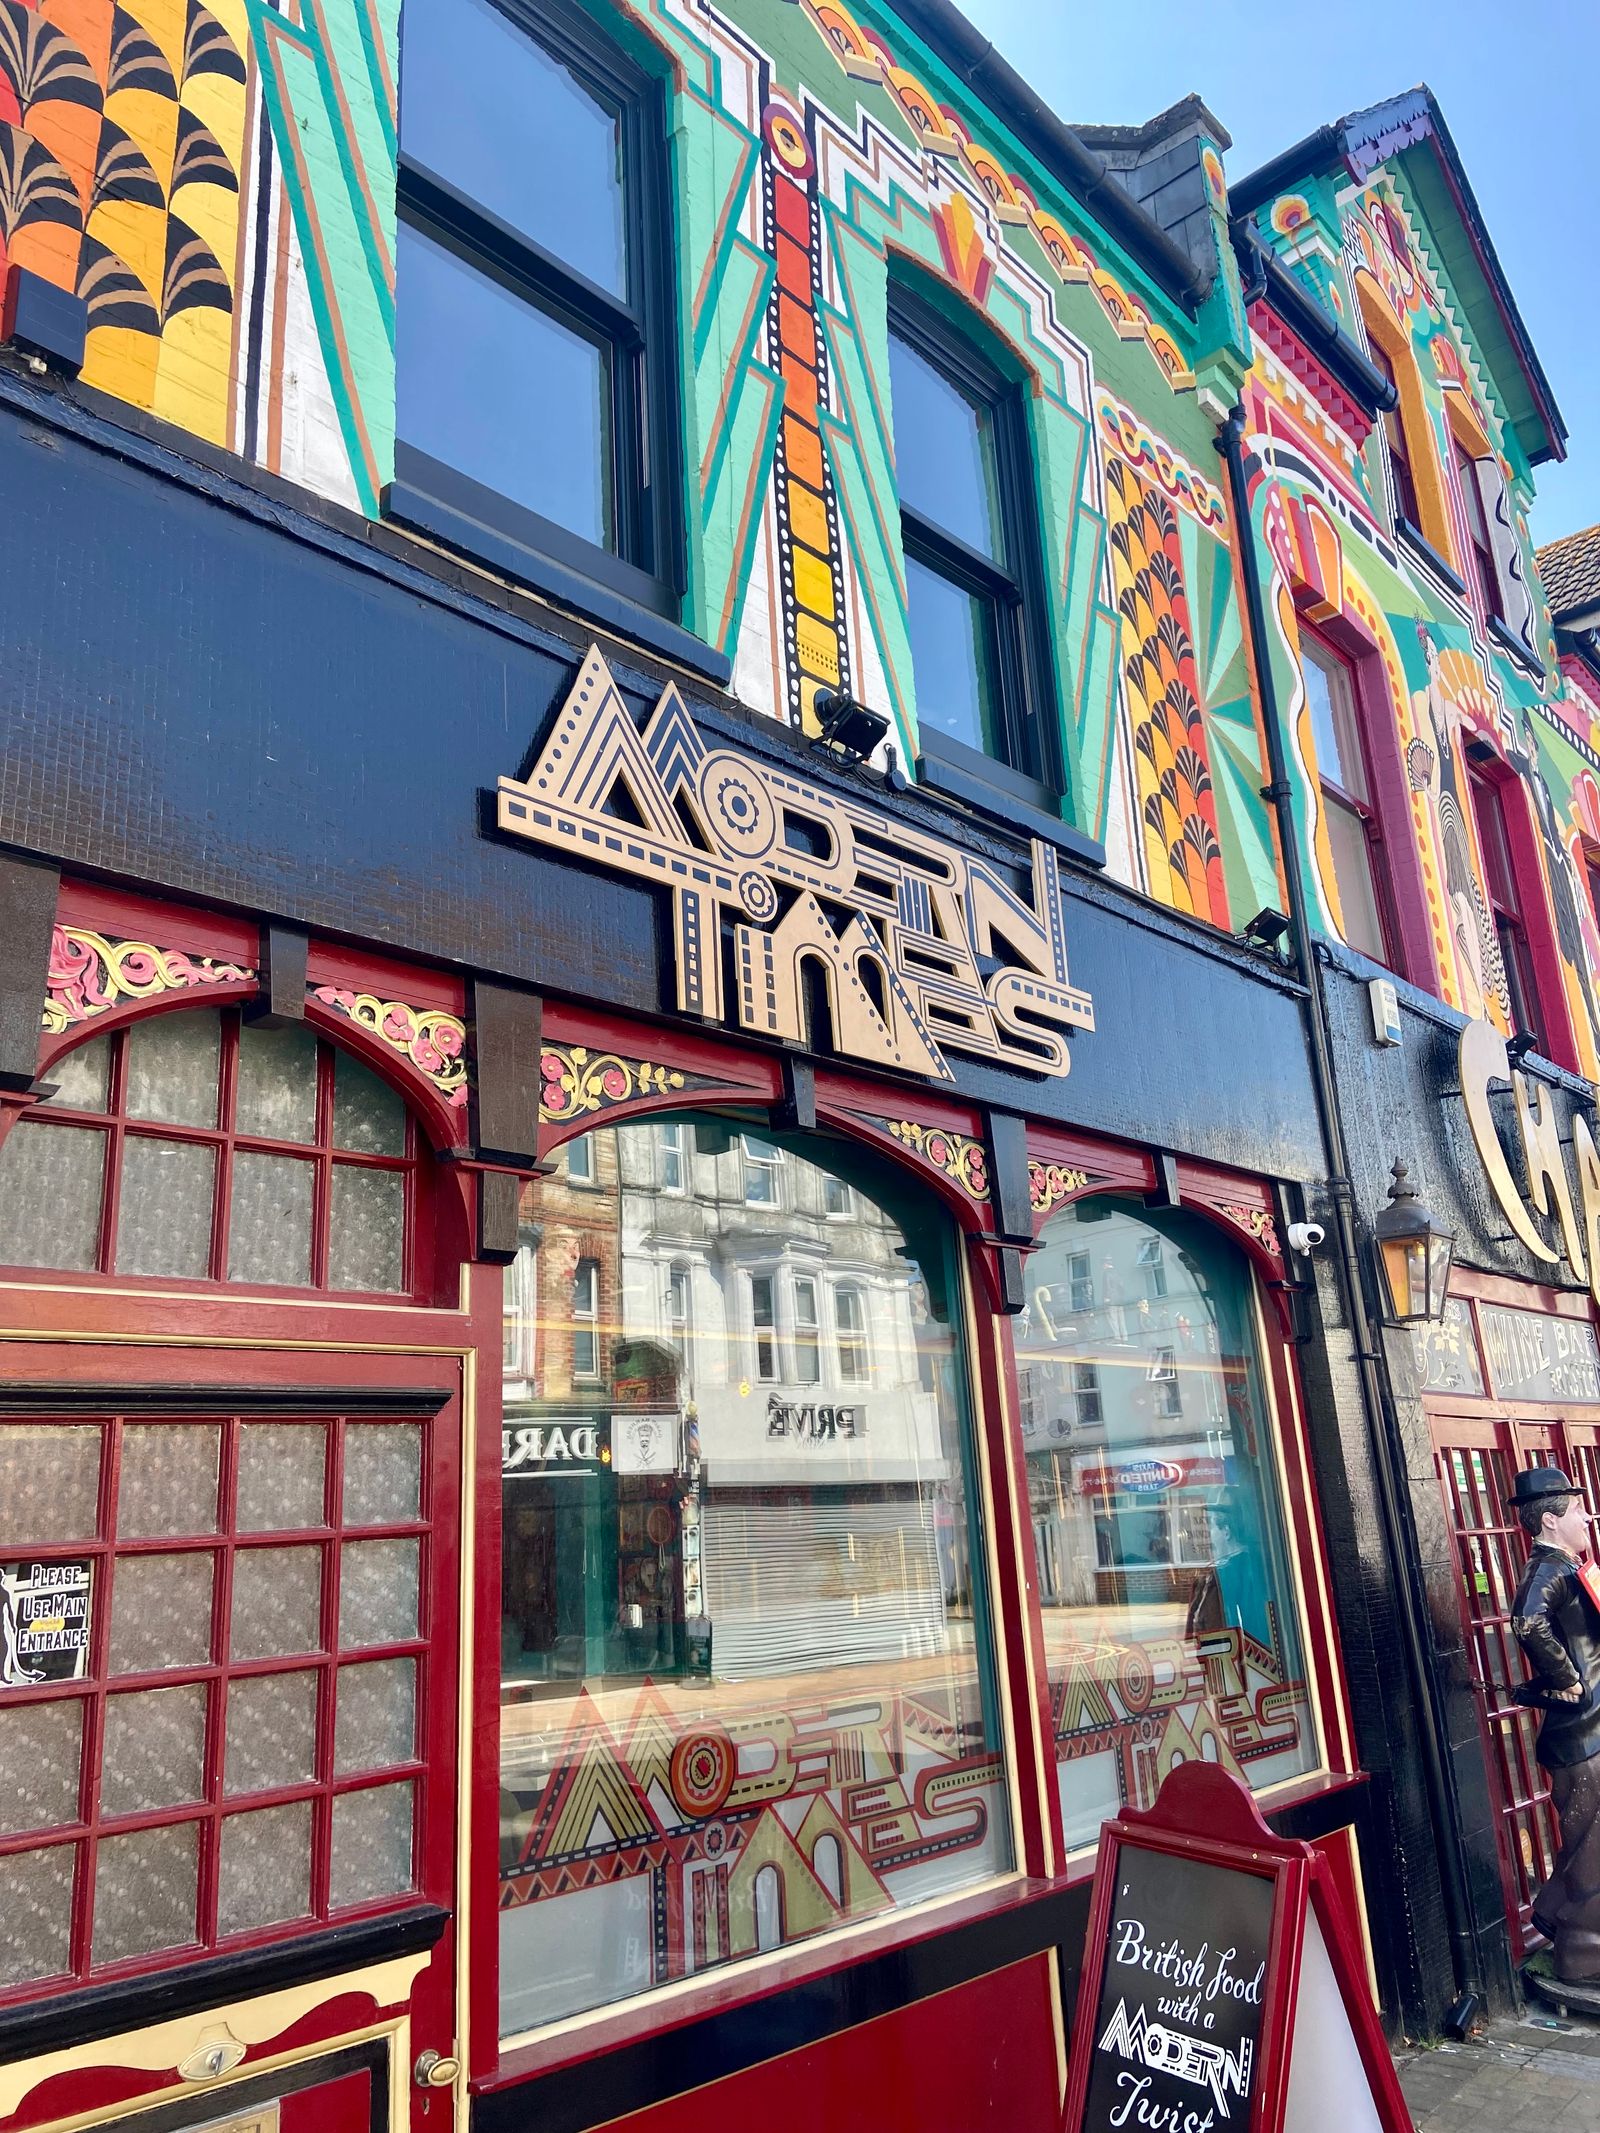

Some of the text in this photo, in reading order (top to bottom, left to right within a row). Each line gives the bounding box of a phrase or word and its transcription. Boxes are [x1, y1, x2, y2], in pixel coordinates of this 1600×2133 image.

[524, 643, 1069, 985] MODERN
[498, 776, 1095, 1082] TIMES
[1480, 1310, 1550, 1388] WINE
[24, 1594, 88, 1621] USE MAIN
[31, 1564, 82, 1588] PLEASE
[18, 1628, 88, 1653] ENTRANCE
[1053, 1600, 1285, 1735] MODERN
[519, 1643, 970, 1863] MODERN
[500, 1754, 1001, 1987] TIMES
[1116, 1919, 1208, 1988] British
[1157, 1991, 1217, 2030] with a
[1098, 1997, 1254, 2119] MODERN
[1109, 2071, 1214, 2133] Twist
